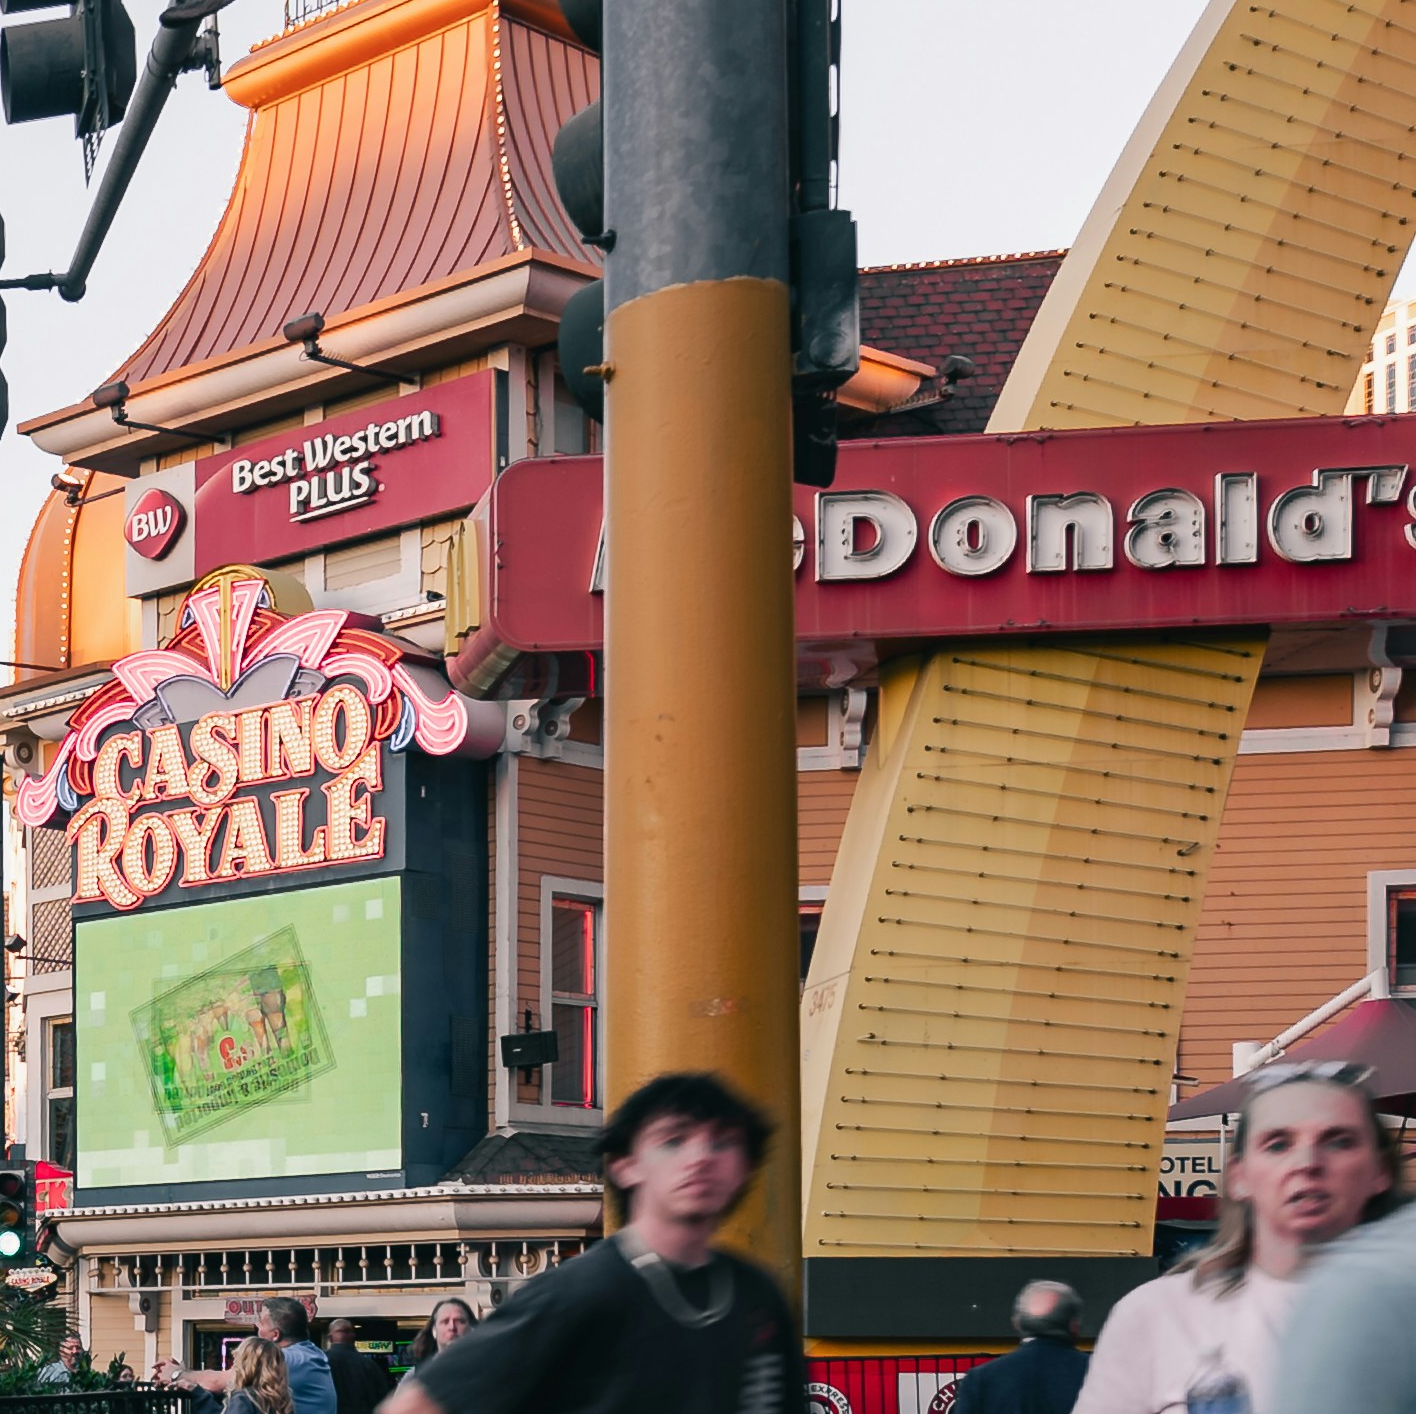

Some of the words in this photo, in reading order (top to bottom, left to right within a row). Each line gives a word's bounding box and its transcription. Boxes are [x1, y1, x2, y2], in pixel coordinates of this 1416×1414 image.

[232, 449, 300, 493] Best
[302, 410, 434, 470] Western
[289, 461, 372, 514] PLUS
[131, 505, 172, 543] BW
[93, 683, 372, 813] CASINO
[67, 740, 387, 911] ROYALE
[1160, 1156, 1222, 1175] OTEL
